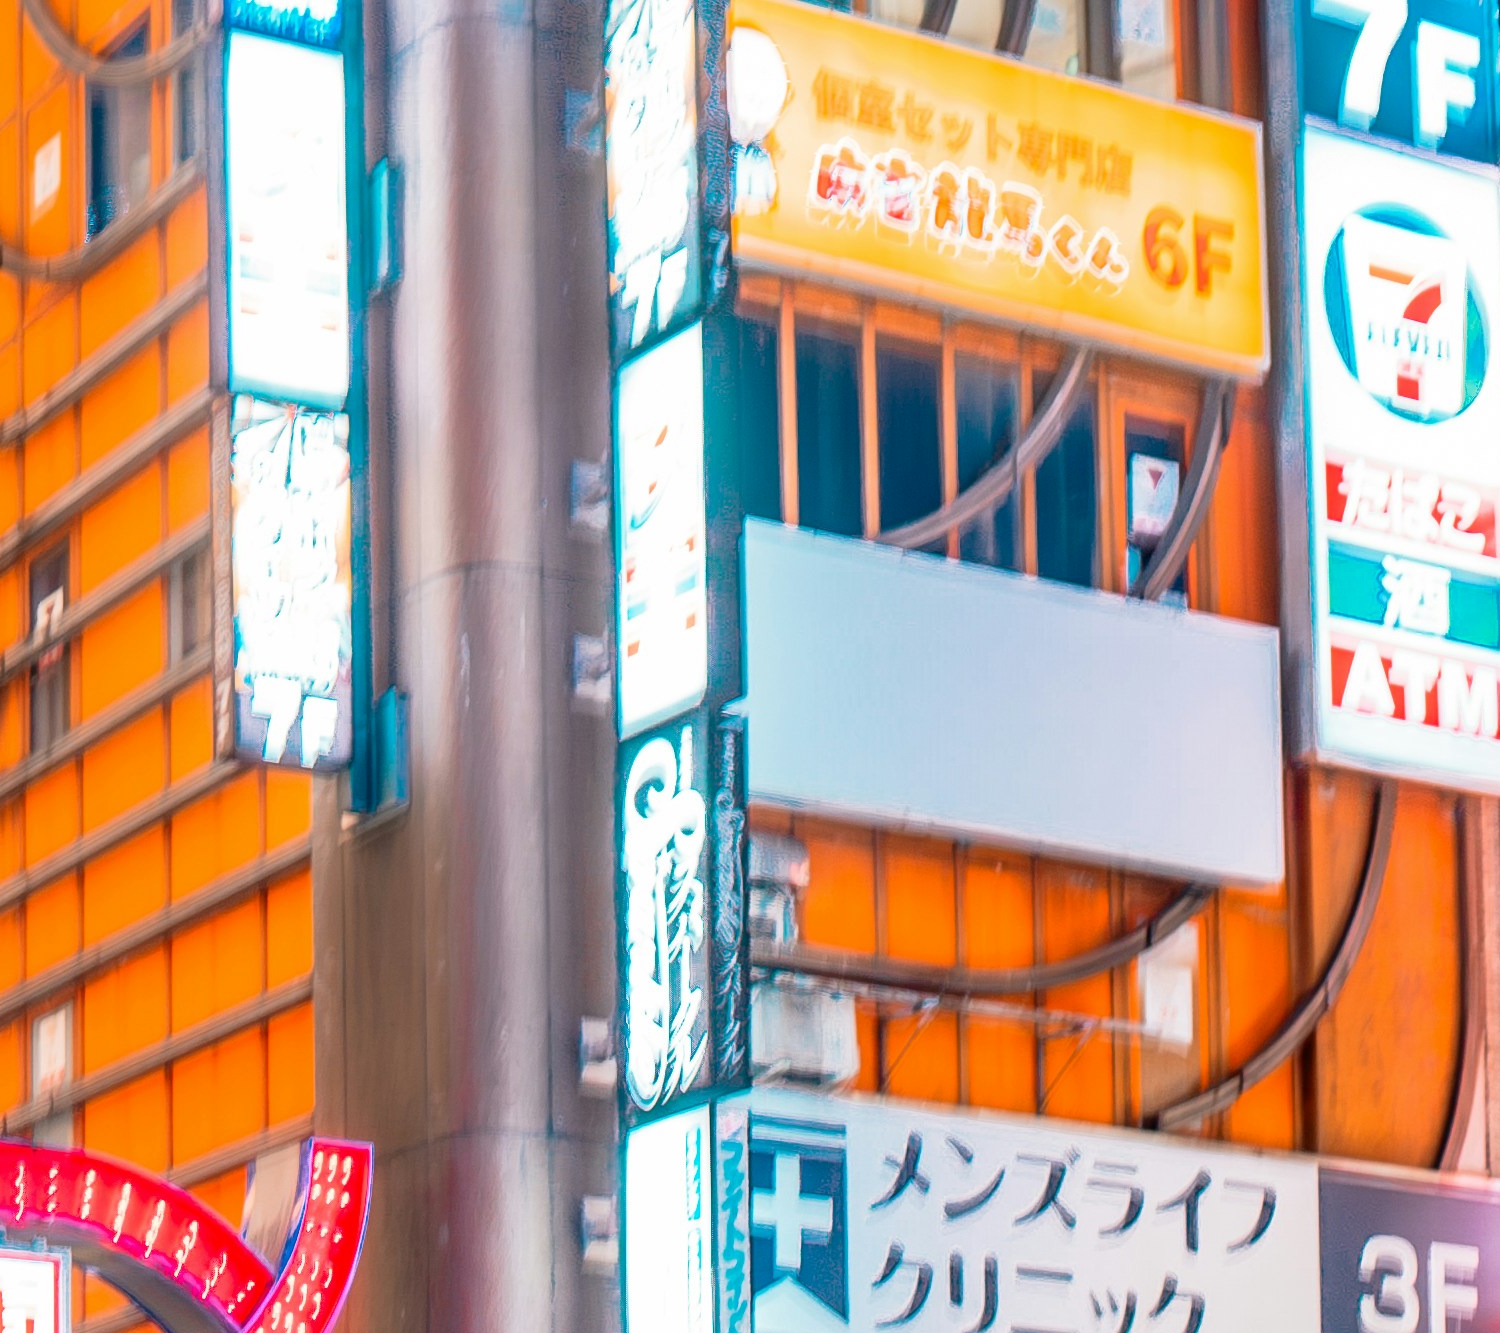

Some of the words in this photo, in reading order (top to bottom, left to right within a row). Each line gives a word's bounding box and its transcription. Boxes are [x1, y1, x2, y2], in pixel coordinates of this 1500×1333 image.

[1143, 203, 1235, 299] 6F
[1338, 457, 1491, 552] たばこ
[1383, 555, 1450, 638] 酒
[870, 1129, 1278, 1257] メンズライフ
